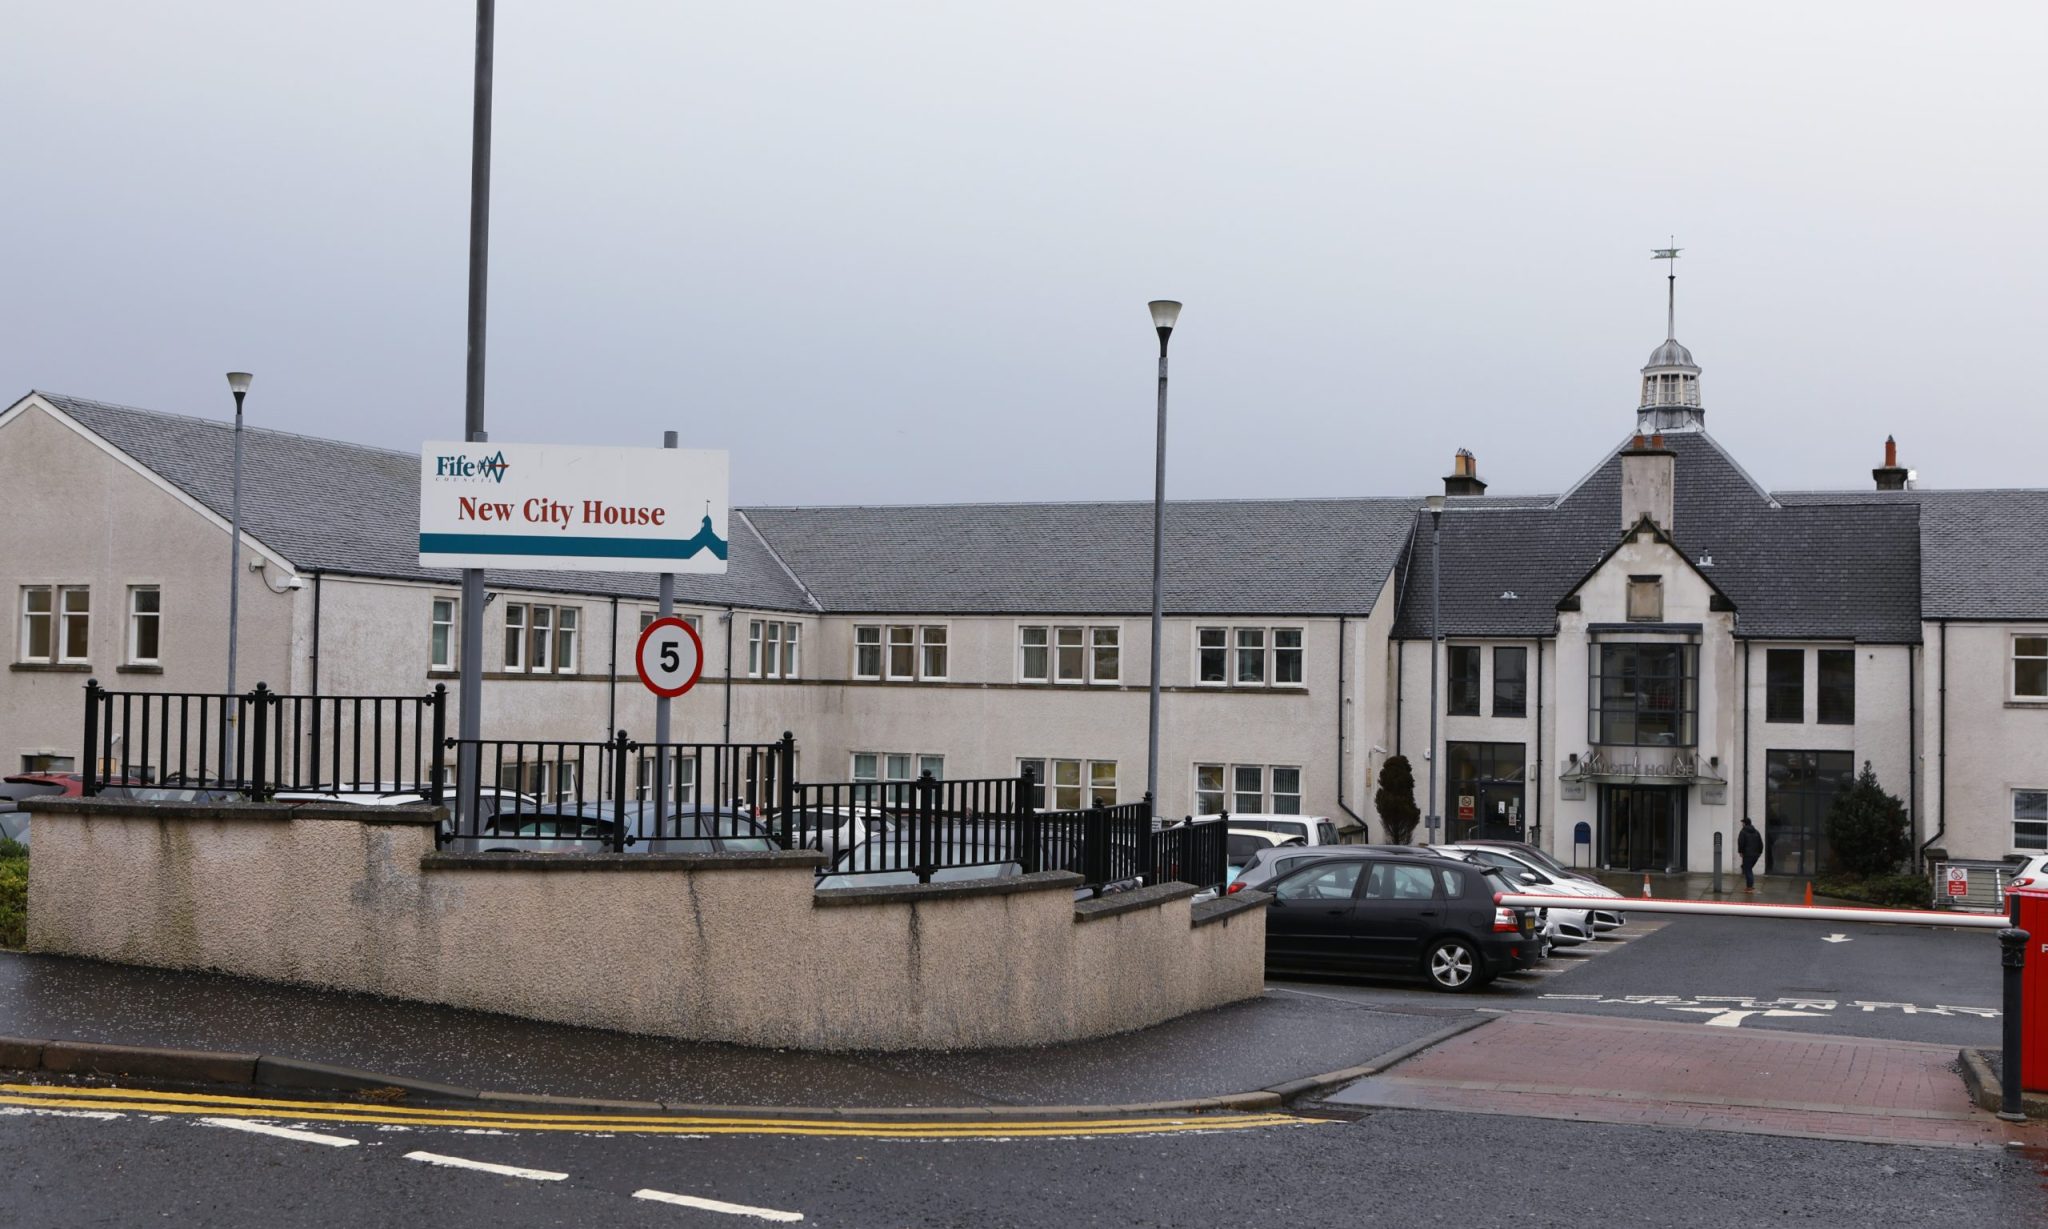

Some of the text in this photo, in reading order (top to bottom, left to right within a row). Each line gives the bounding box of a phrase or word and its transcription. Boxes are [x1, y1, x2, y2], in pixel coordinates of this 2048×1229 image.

[436, 455, 475, 477] Fife
[458, 497, 666, 531] New City House
[660, 641, 680, 674] 5
[1644, 763, 1695, 777] HOUSE
